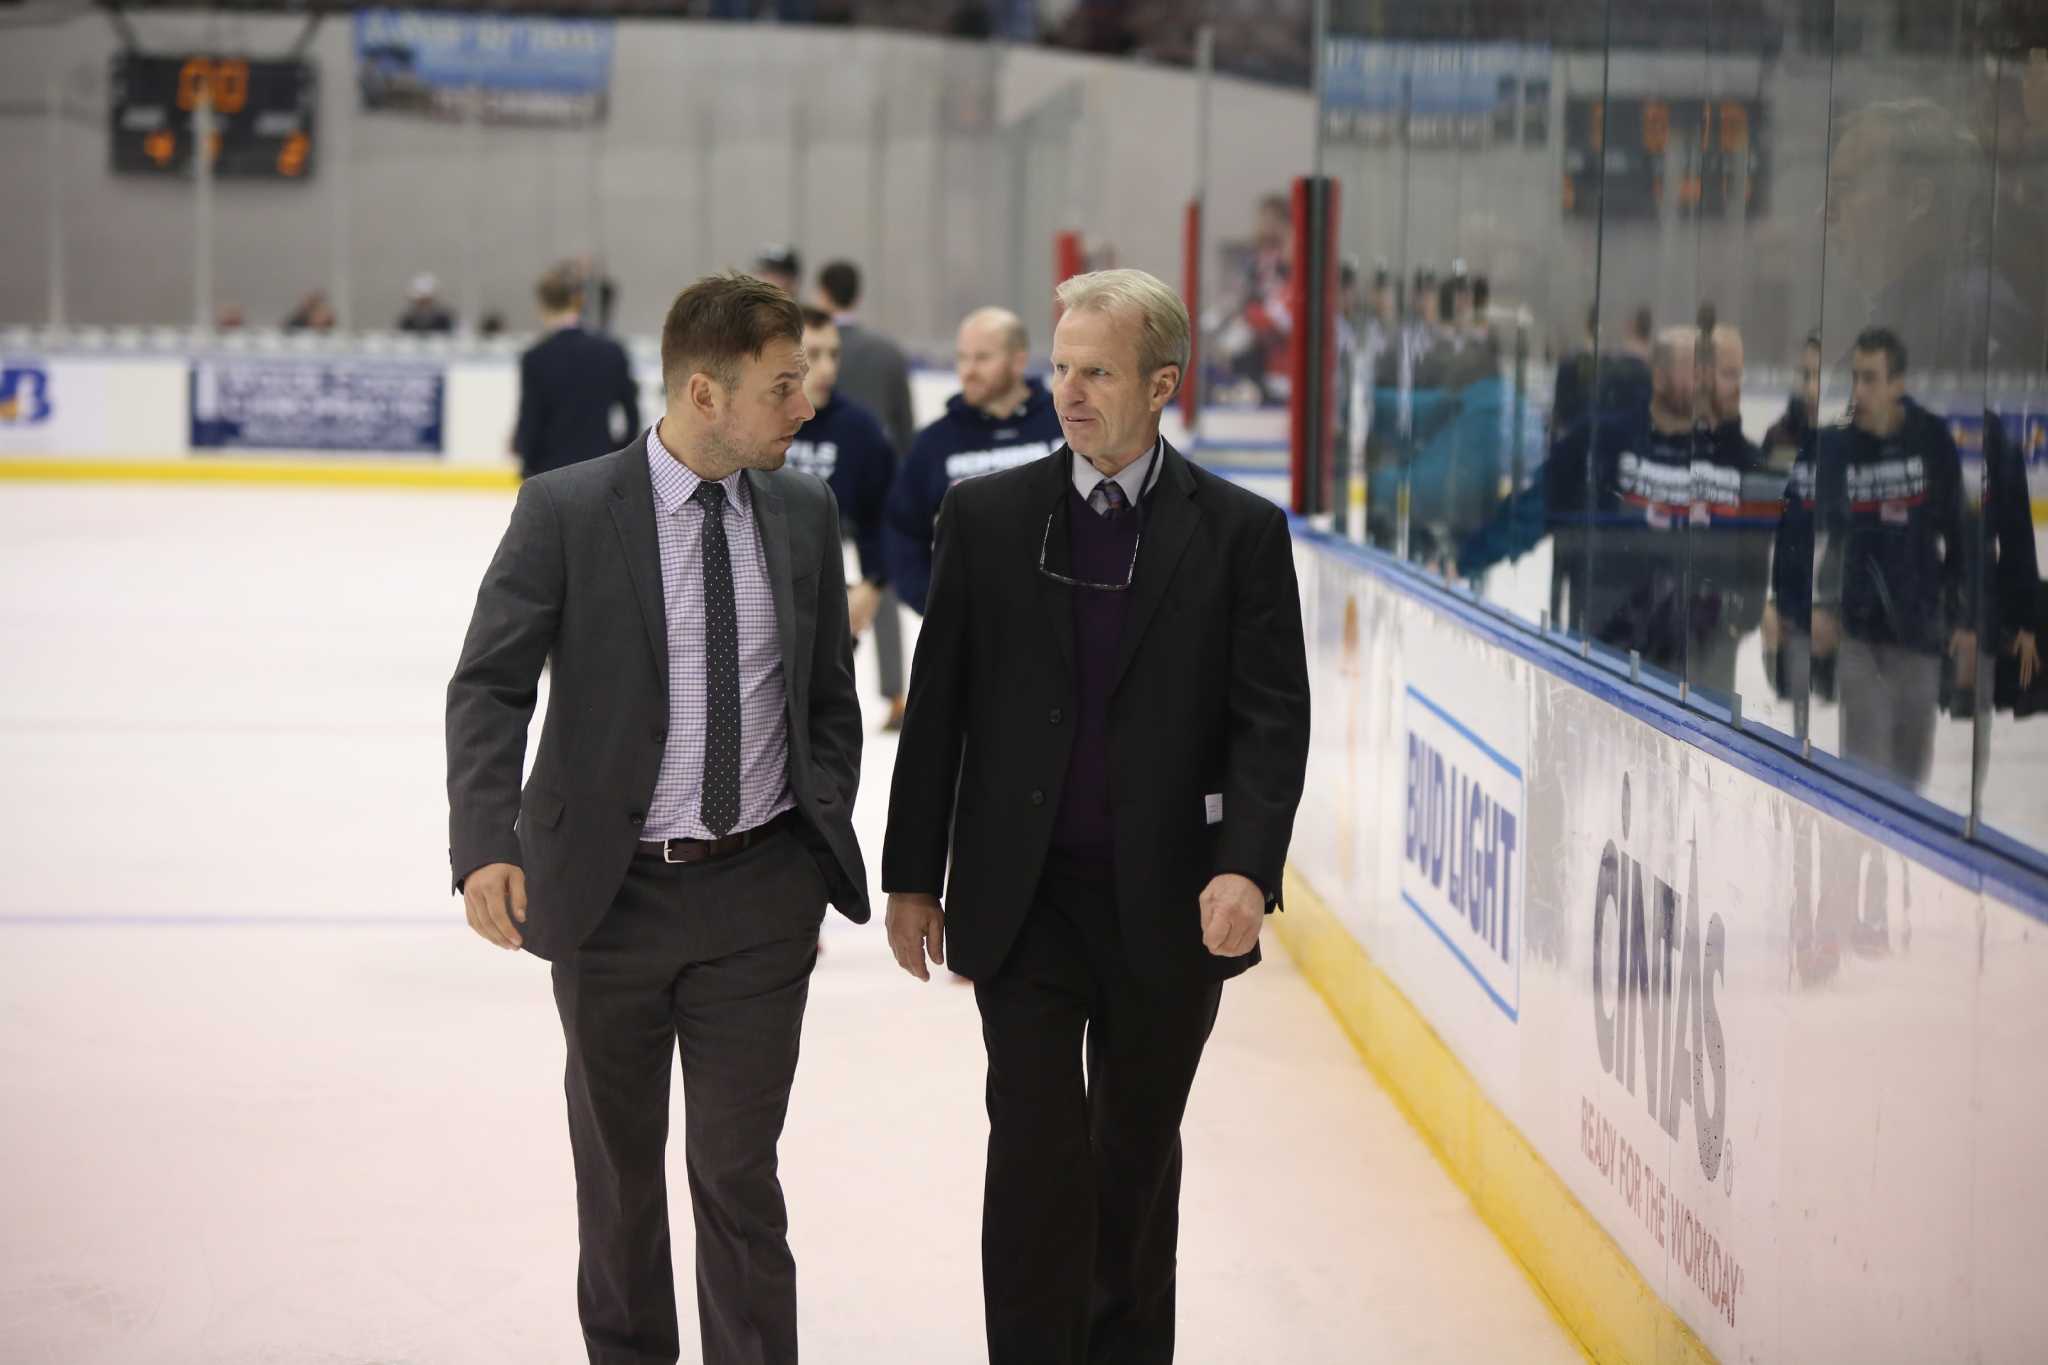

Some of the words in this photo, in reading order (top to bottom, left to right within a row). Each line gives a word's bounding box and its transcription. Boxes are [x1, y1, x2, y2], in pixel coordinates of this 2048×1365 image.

[1405, 729, 1446, 891] BUD
[1448, 764, 1517, 965] LIGHT
[1581, 1095, 1616, 1186] READY
[1619, 1136, 1642, 1220] FOR
[1645, 1164, 1667, 1249] THE
[1670, 1192, 1740, 1328] WORKDAY
